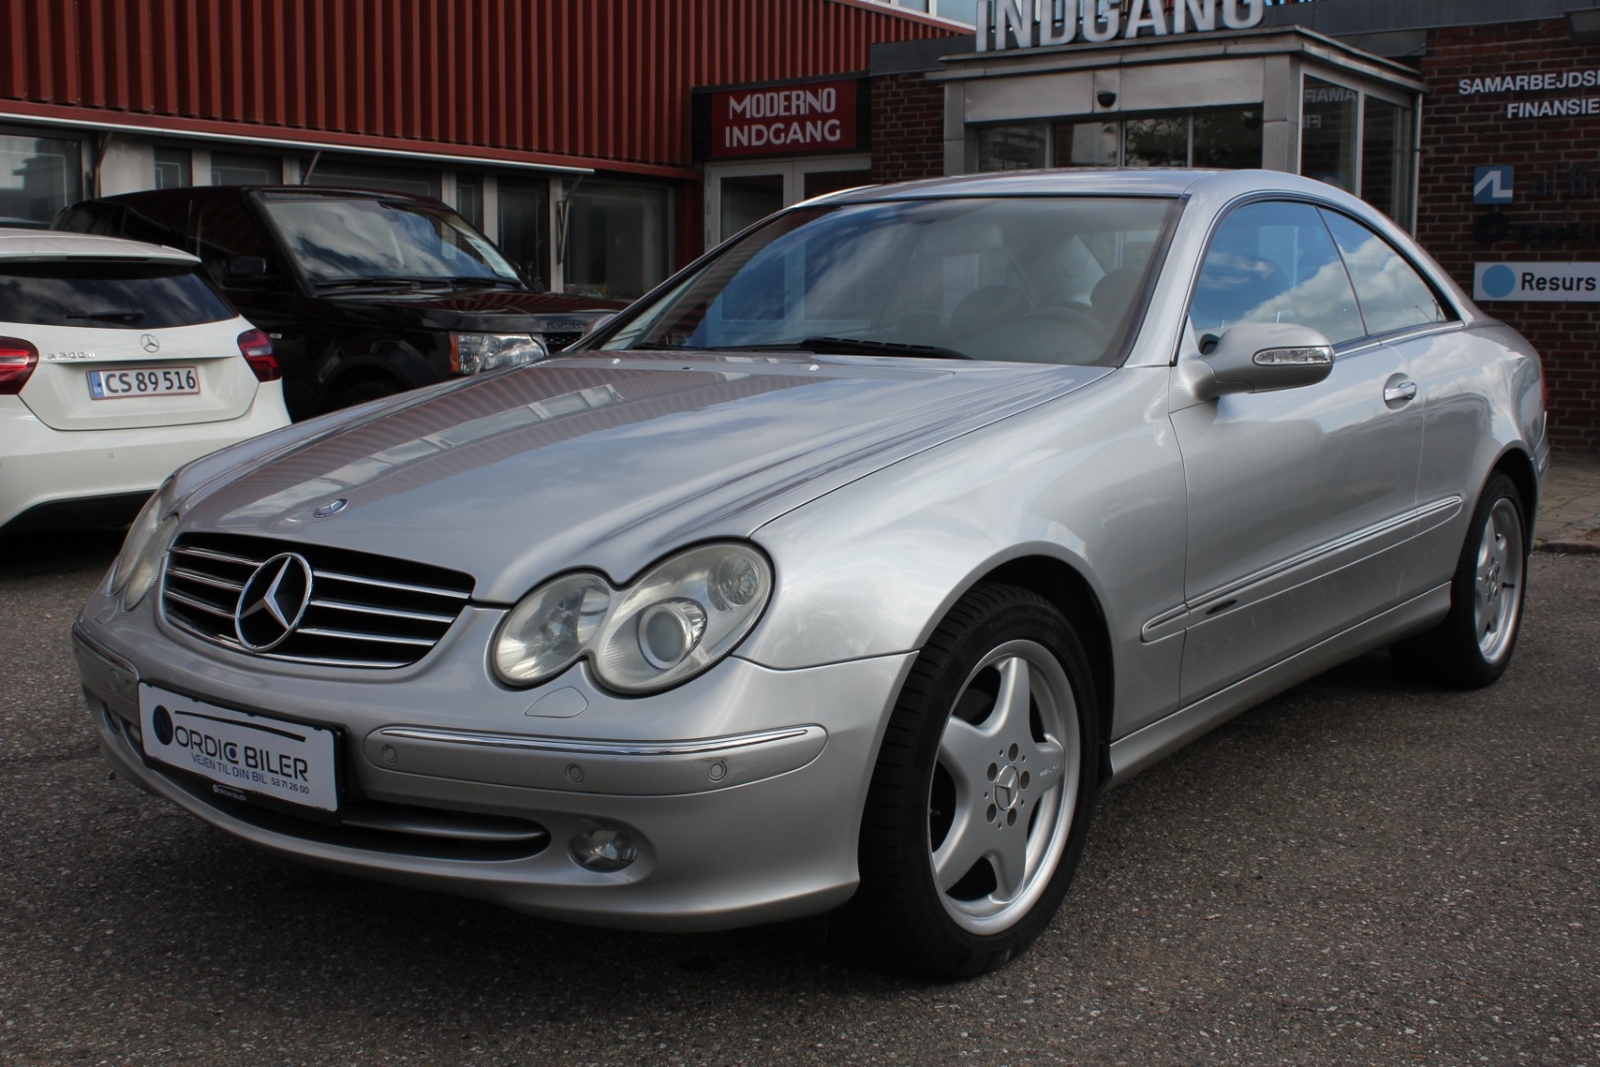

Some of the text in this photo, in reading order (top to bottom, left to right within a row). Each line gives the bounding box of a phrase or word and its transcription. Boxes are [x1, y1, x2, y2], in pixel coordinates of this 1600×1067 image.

[729, 87, 837, 120] MODERNO
[725, 119, 841, 148] INDGANG
[1521, 272, 1597, 291] Resurs
[105, 370, 196, 394] CS 89 516
[191, 752, 216, 770] VEJEN
[216, 762, 231, 775] TIL
[232, 766, 250, 780] DIN
[252, 772, 268, 784] BIL
[244, 746, 309, 782] BILER
